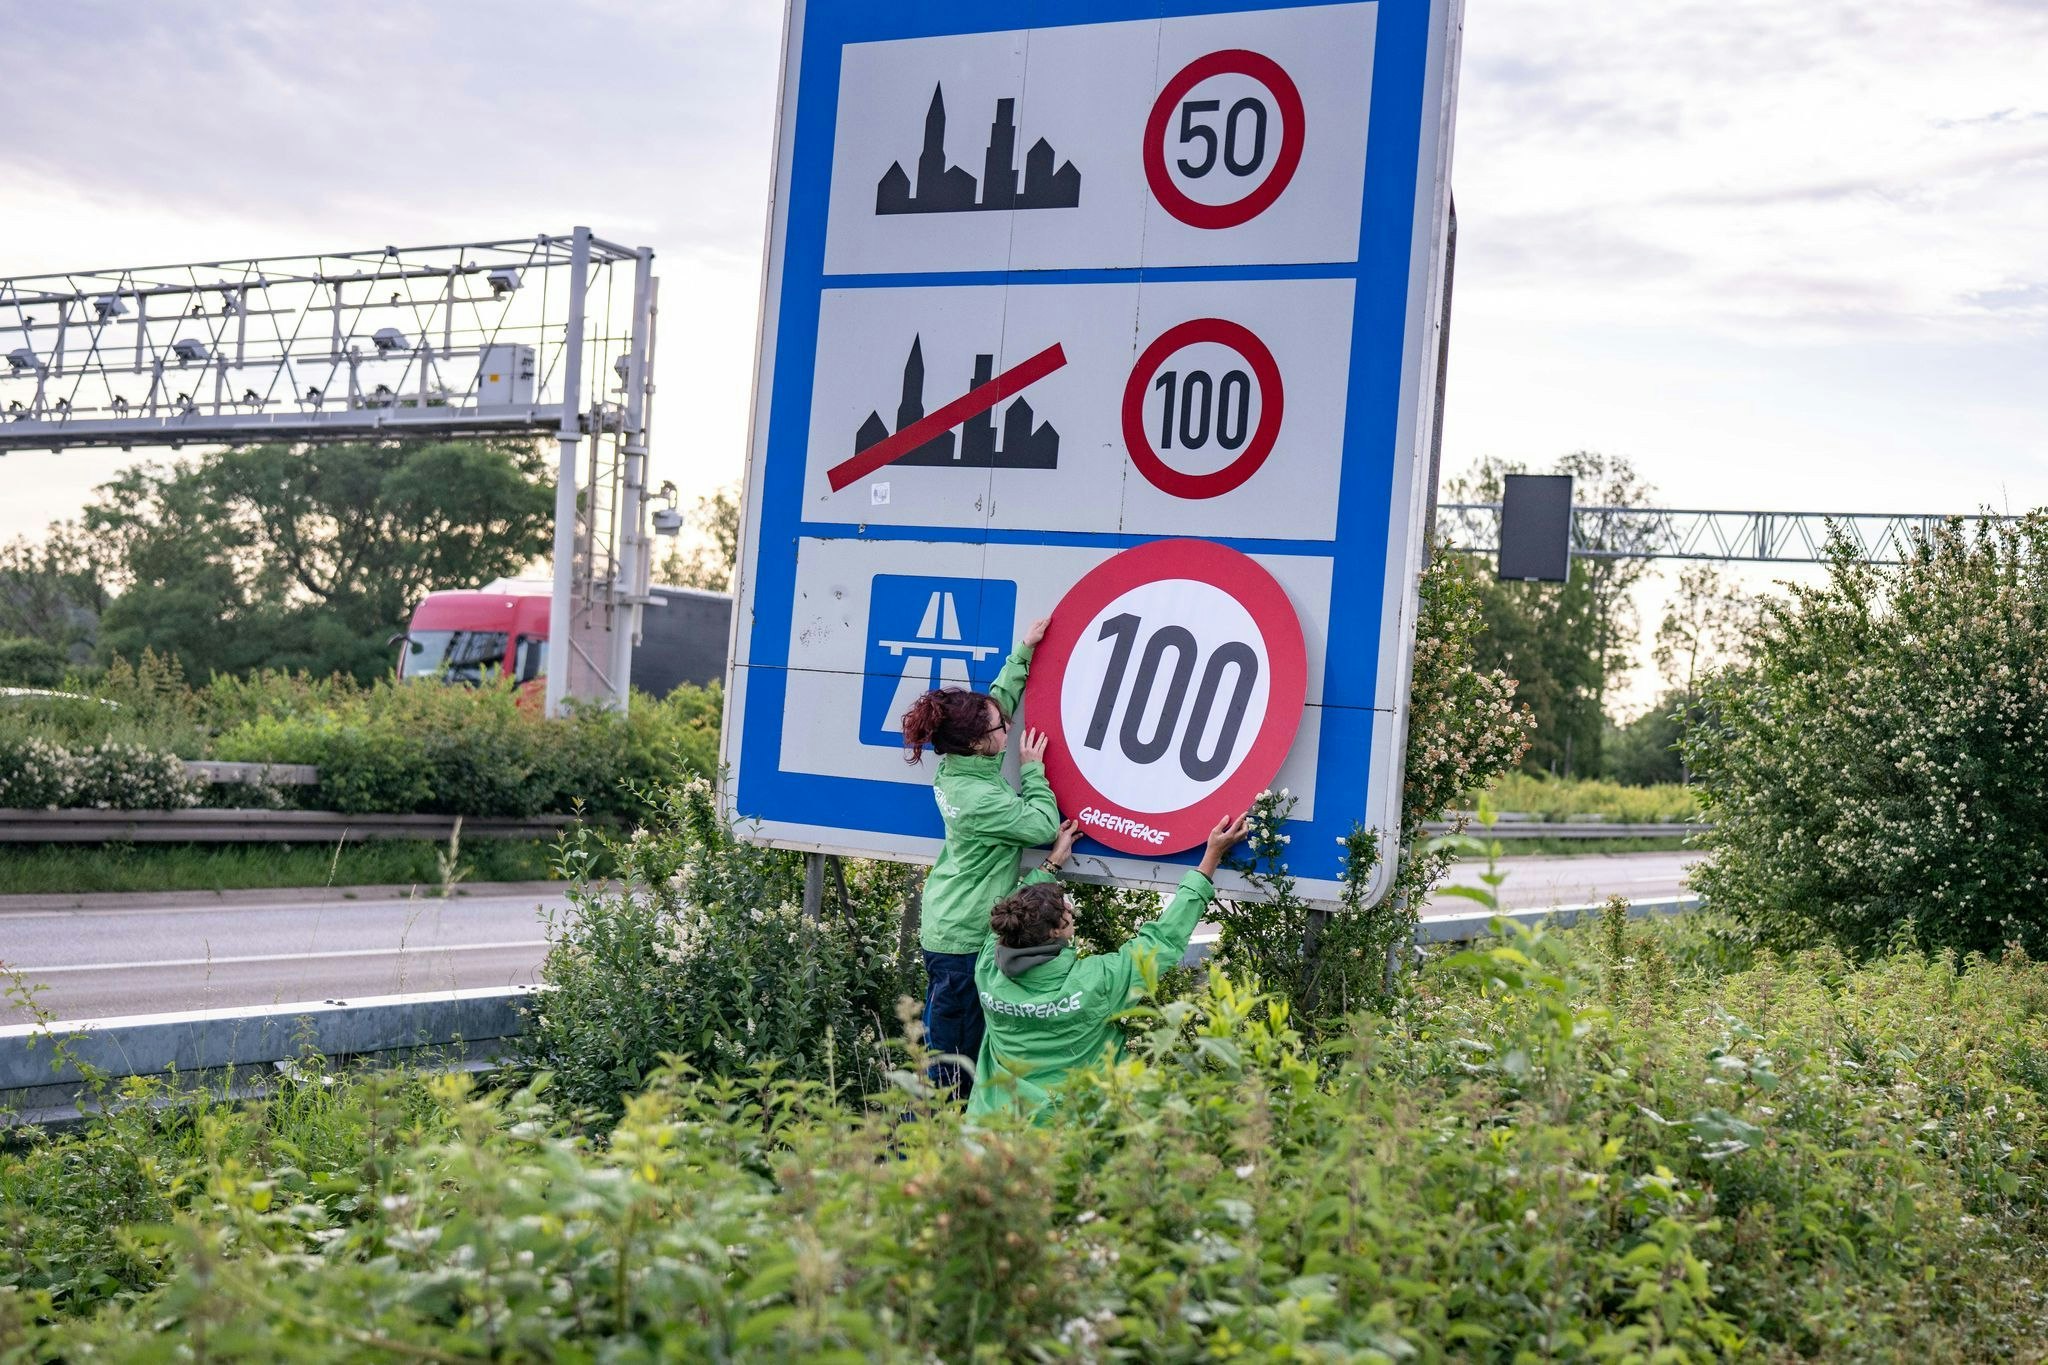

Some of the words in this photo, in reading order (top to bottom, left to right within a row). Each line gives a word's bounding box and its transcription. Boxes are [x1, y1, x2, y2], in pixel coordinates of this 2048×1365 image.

[1177, 97, 1267, 179] 50
[1155, 370, 1250, 450] 100
[1083, 612, 1259, 782] 100
[1079, 806, 1170, 845] GREENPEACE
[979, 991, 1083, 1018] GREENPEACE
